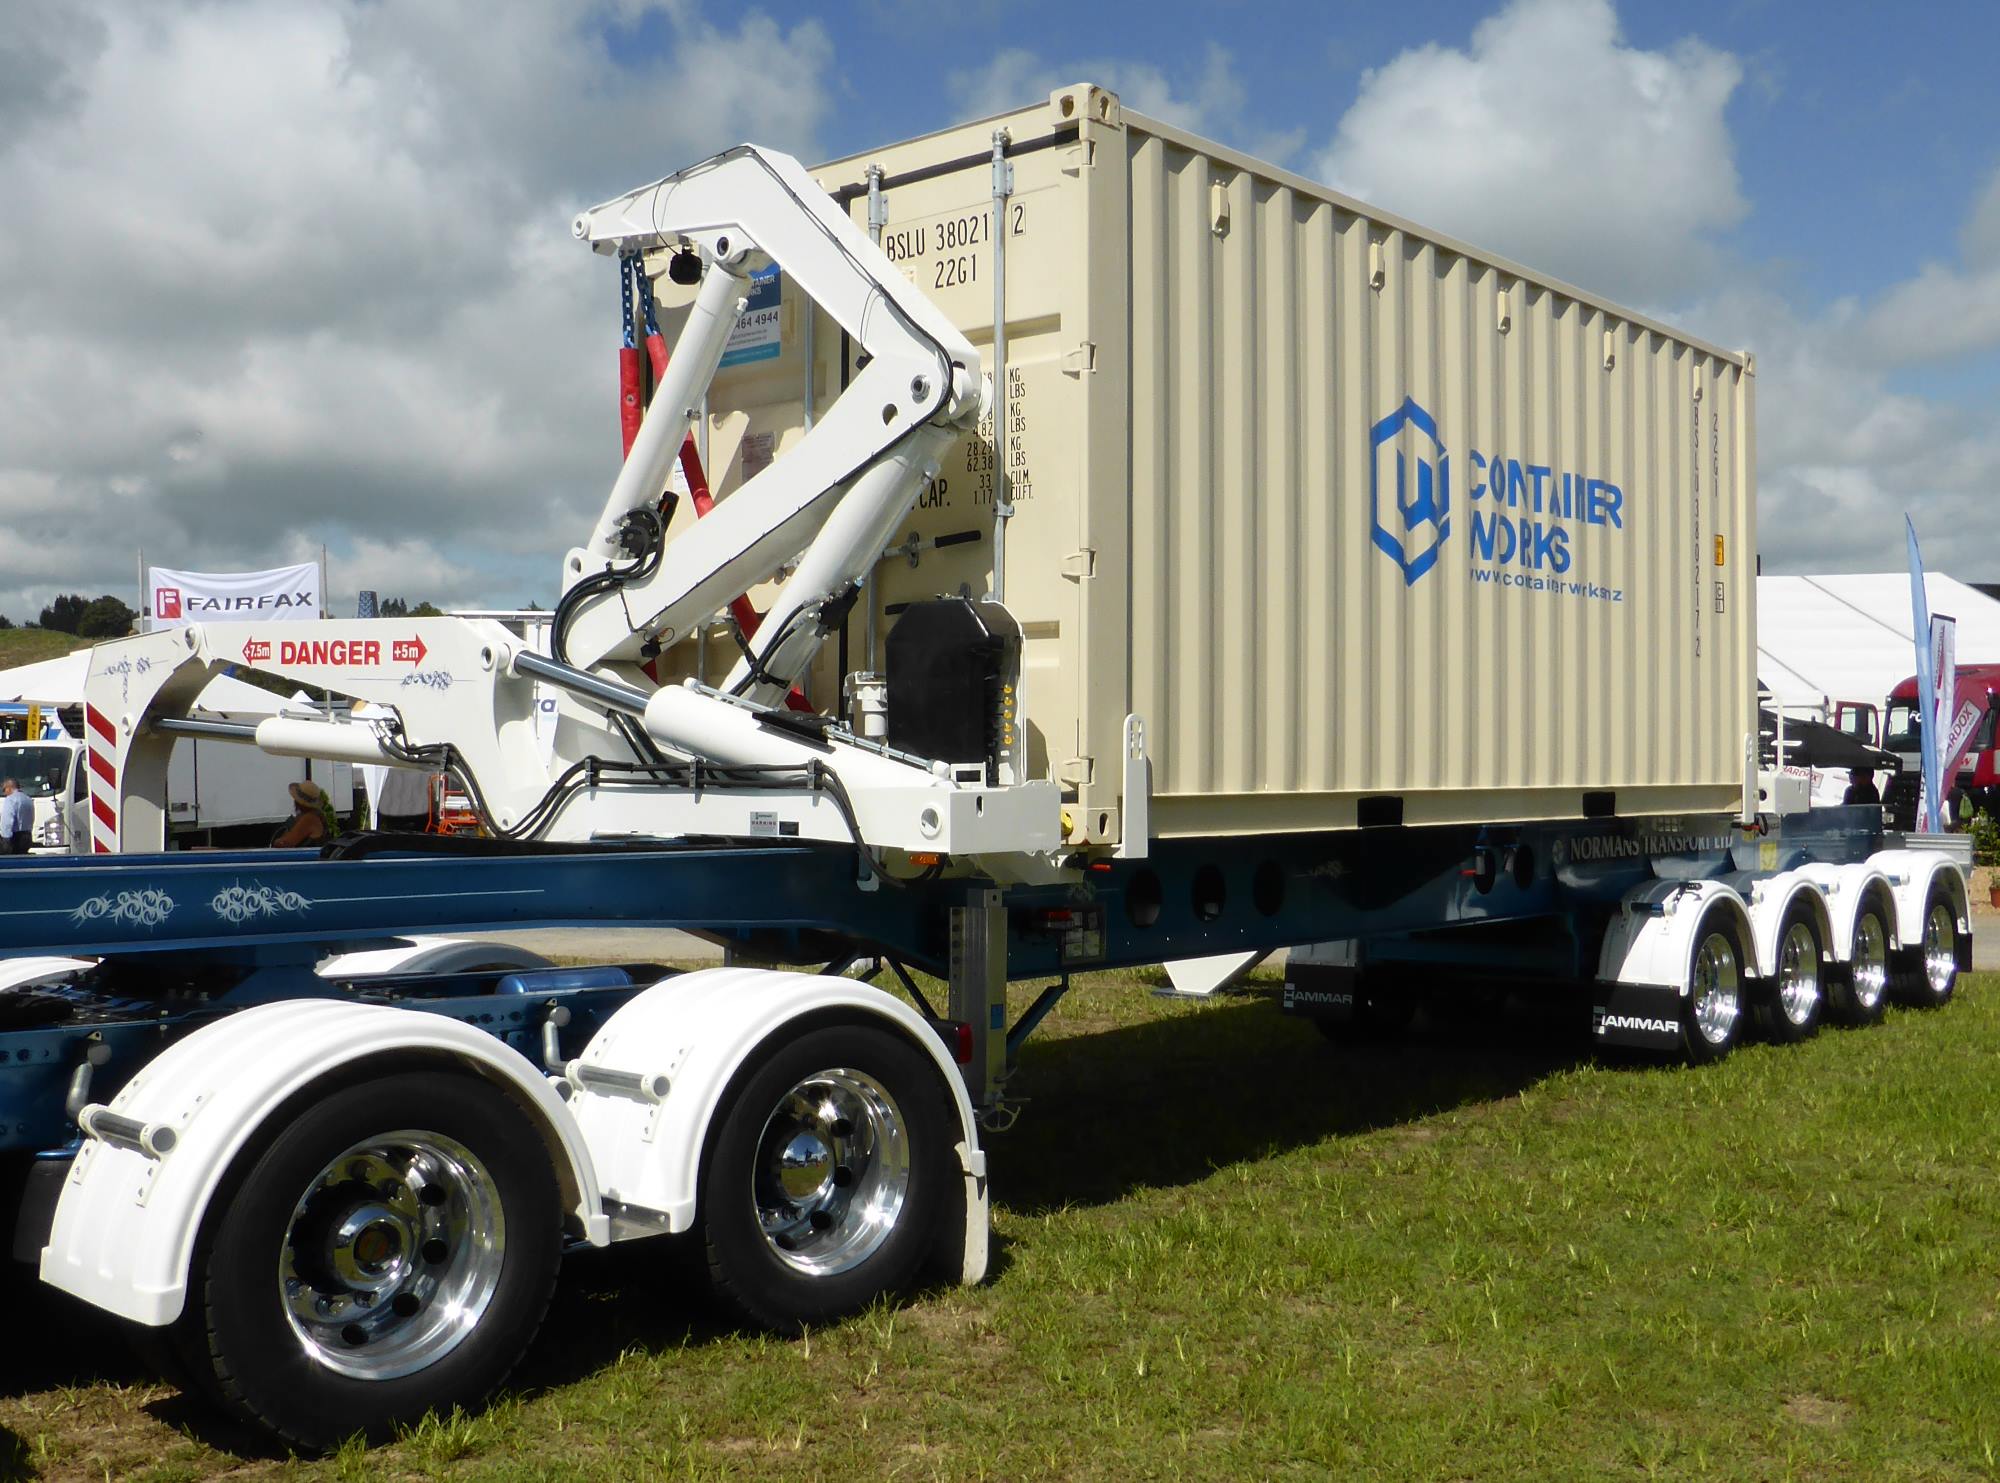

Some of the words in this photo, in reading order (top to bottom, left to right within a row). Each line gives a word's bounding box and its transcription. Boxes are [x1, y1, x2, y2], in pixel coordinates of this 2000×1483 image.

[886, 227, 926, 262] BSLU
[934, 211, 995, 251] 38021
[1013, 204, 1025, 235] 2
[934, 253, 976, 289] 22G1
[755, 311, 779, 326] 4944
[1009, 367, 1021, 383] KG
[1009, 382, 1026, 399] LBS
[1010, 402, 1021, 417] KG
[1010, 416, 1026, 433] LBS
[1010, 436, 1021, 451] KG
[1010, 451, 1026, 467] LBS
[187, 592, 312, 611] FAIRFAX
[244, 644, 270, 657] +7.5m
[280, 640, 380, 665] DANGER
[394, 644, 419, 659] +5m
[1946, 705, 1973, 753] ARDOX
[1570, 835, 1640, 861] NORMANS
[1283, 990, 1353, 1005] HAMMAR
[1593, 1014, 1679, 1034] HAMMAR
